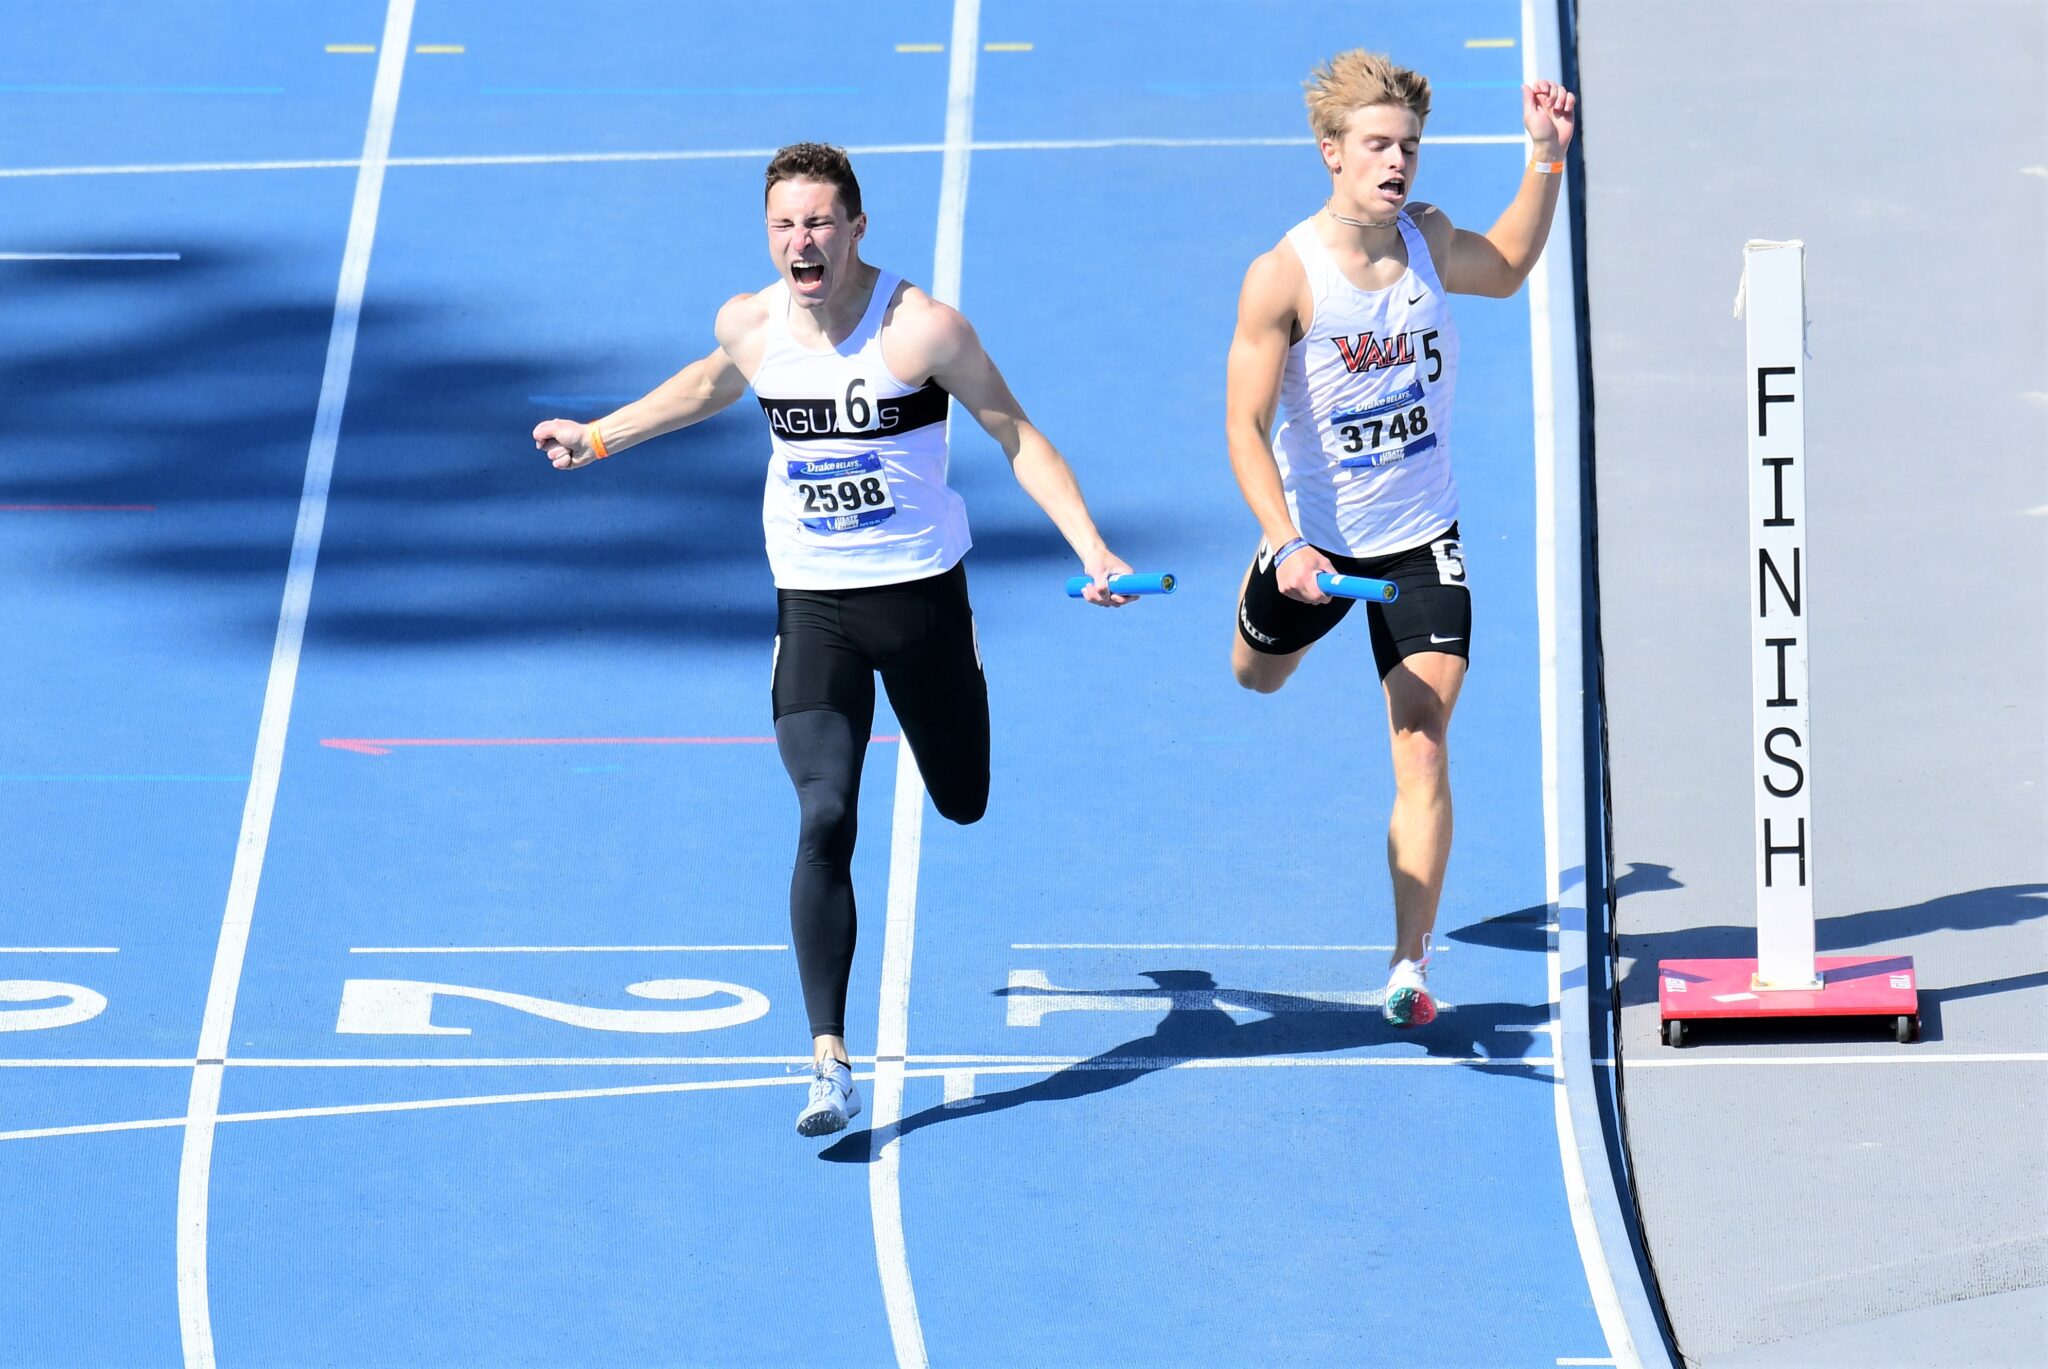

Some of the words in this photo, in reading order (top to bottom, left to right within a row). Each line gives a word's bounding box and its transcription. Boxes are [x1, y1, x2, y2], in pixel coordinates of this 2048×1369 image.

[1422, 330, 1443, 383] 5
[845, 378, 871, 429] 6
[1386, 390, 1410, 404] RELAYS
[1340, 405, 1429, 453] 3748
[806, 461, 836, 473] Drake
[835, 460, 859, 470] RELAYS
[799, 477, 885, 513] 2598
[1757, 366, 1806, 888] FINISH
[335, 978, 771, 1035] 2
